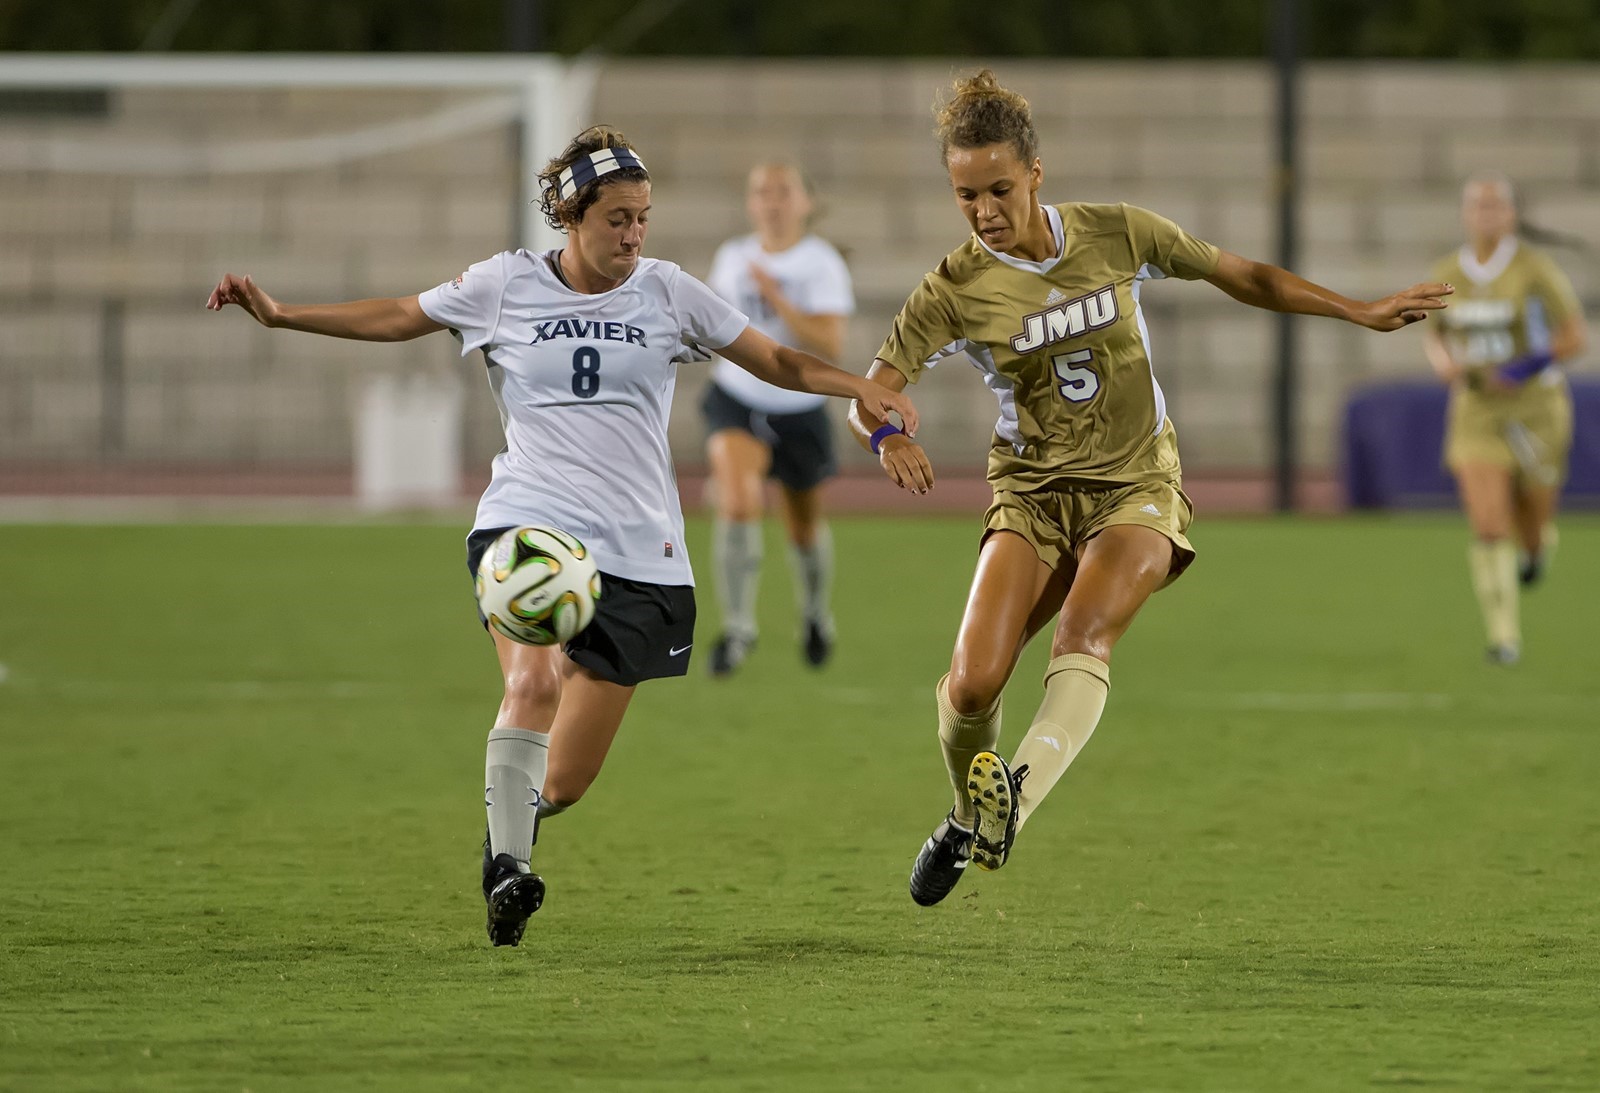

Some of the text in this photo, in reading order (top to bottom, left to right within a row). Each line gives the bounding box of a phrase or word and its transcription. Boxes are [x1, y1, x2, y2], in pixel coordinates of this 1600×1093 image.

[529, 319, 648, 348] XAVIER
[1010, 284, 1119, 355] JMU
[571, 346, 601, 399] 8
[1052, 348, 1100, 403] 5
